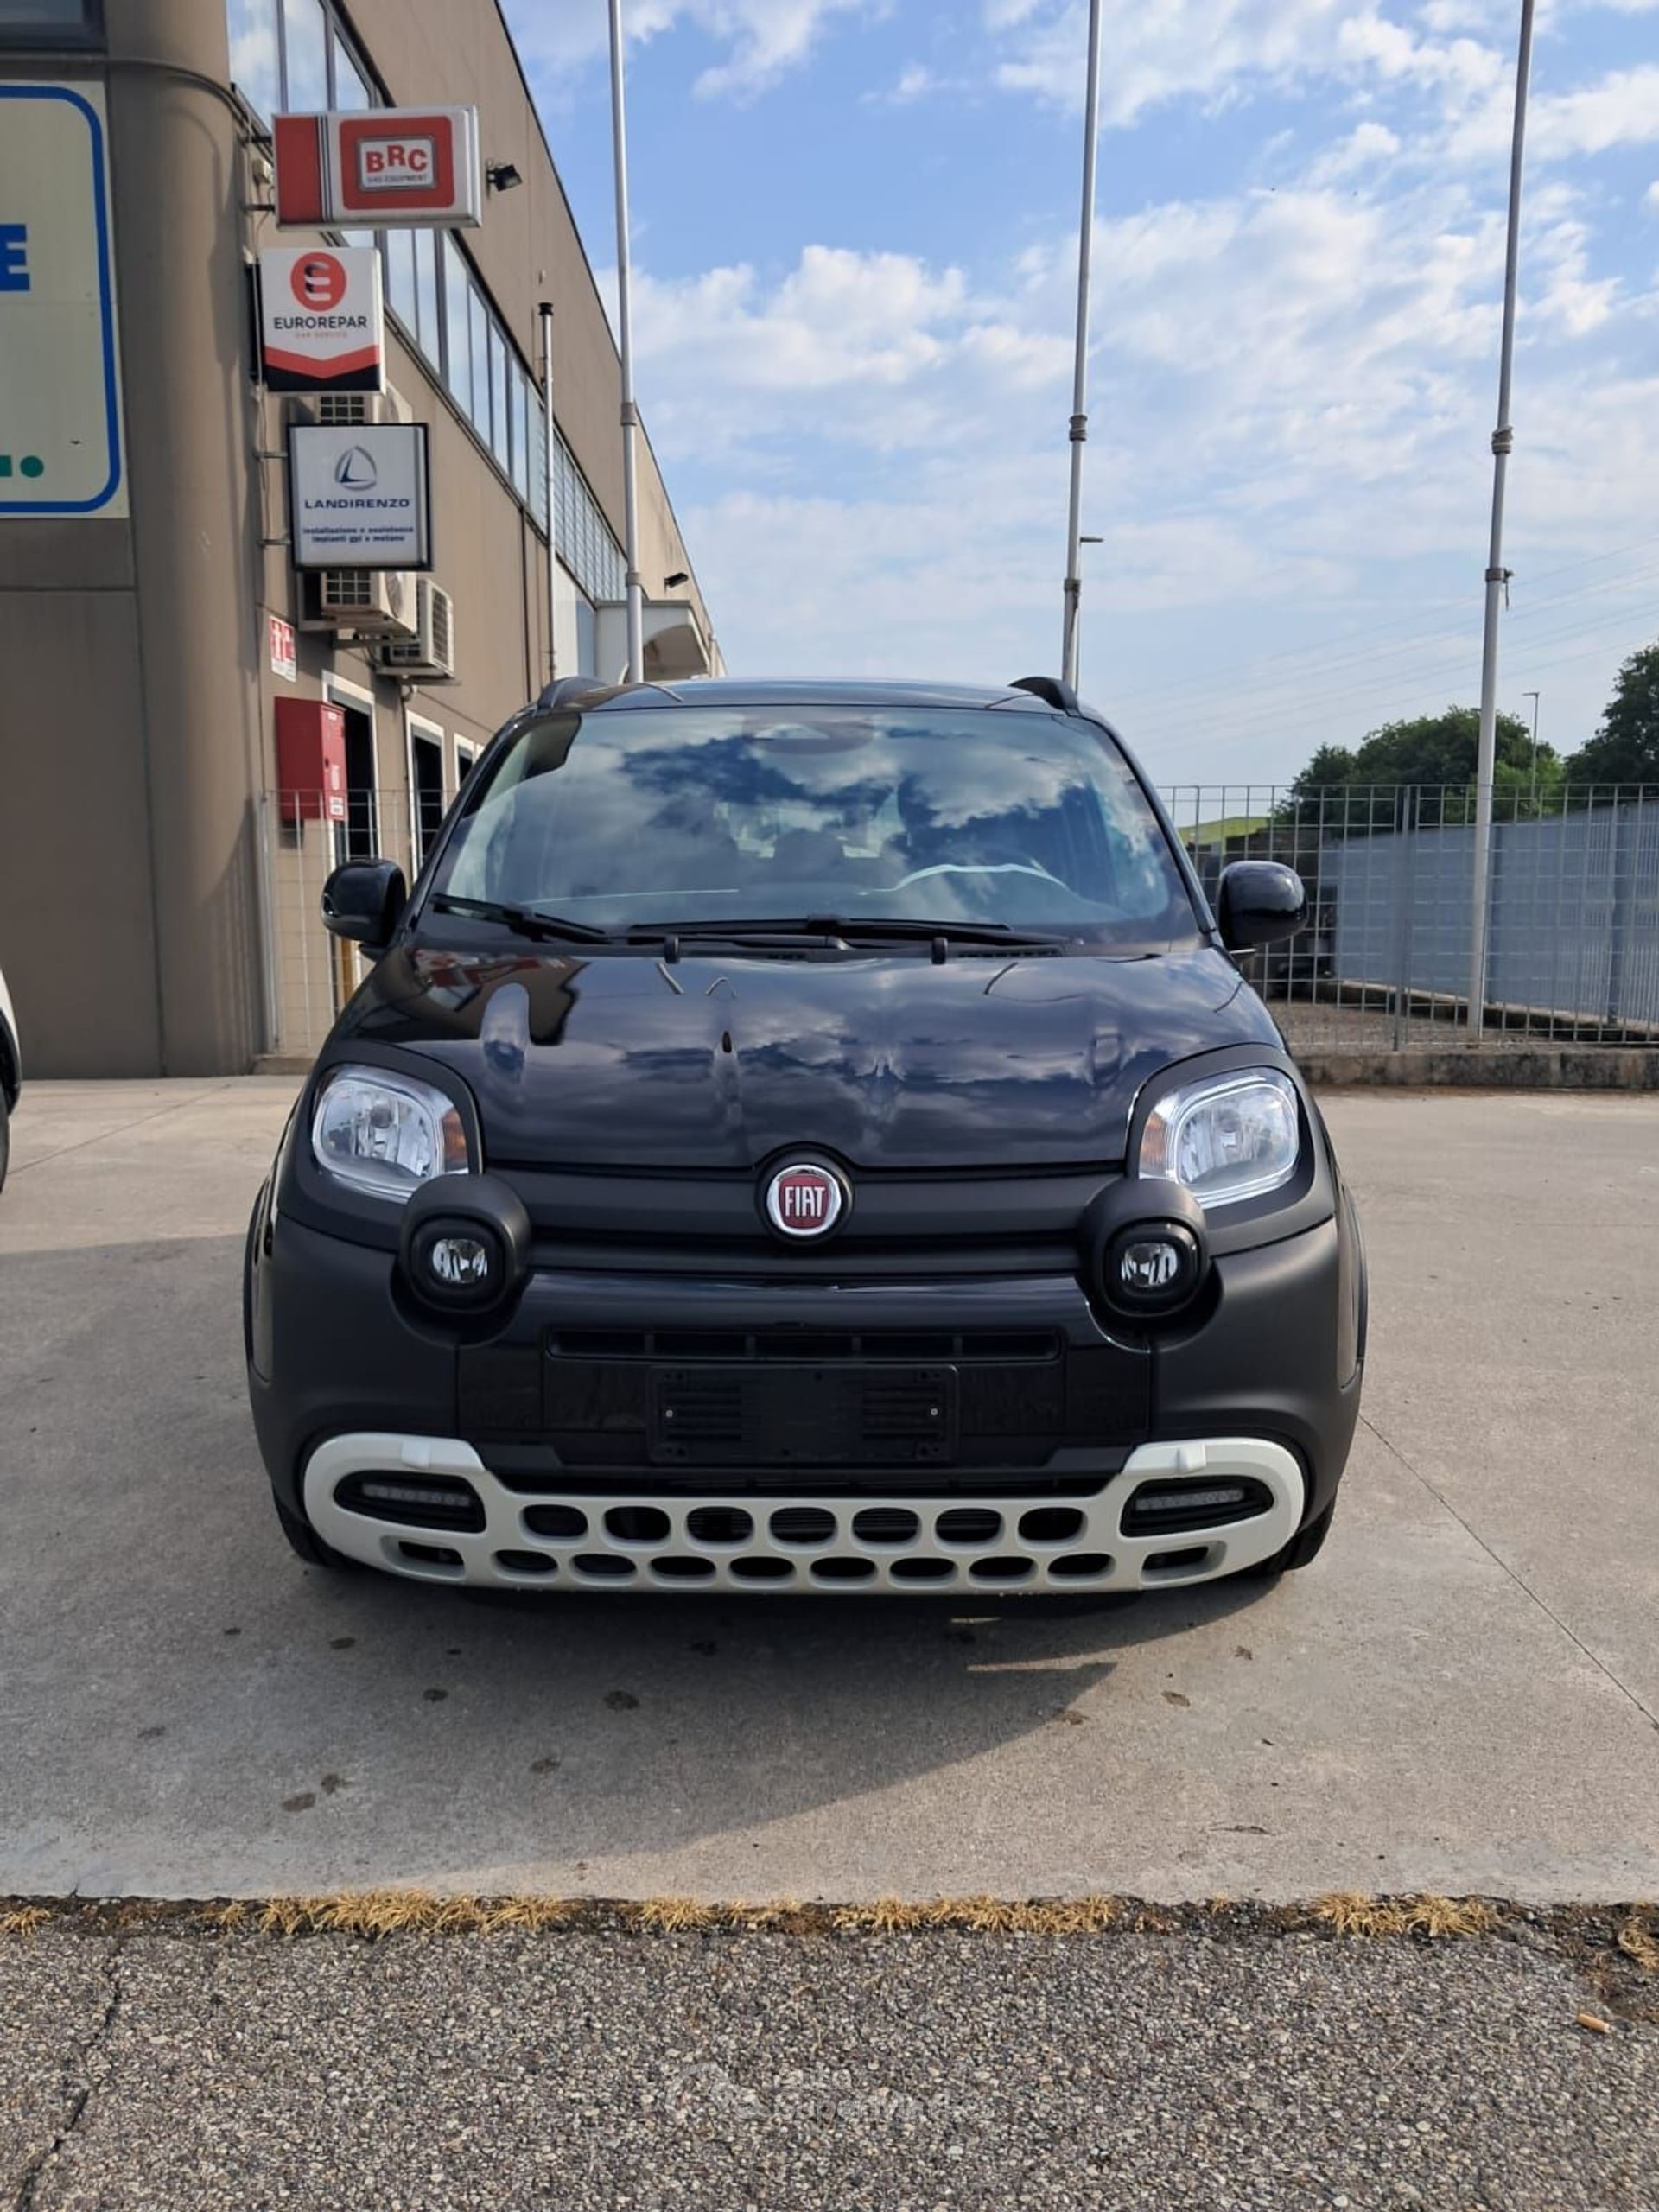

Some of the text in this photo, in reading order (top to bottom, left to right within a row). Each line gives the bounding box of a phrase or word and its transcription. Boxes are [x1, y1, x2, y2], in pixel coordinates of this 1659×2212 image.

[366, 144, 428, 173] BRC
[274, 316, 367, 329] EUROREPAR
[305, 499, 410, 509] LANDIRENZO
[785, 1185, 826, 1217] FIAT
